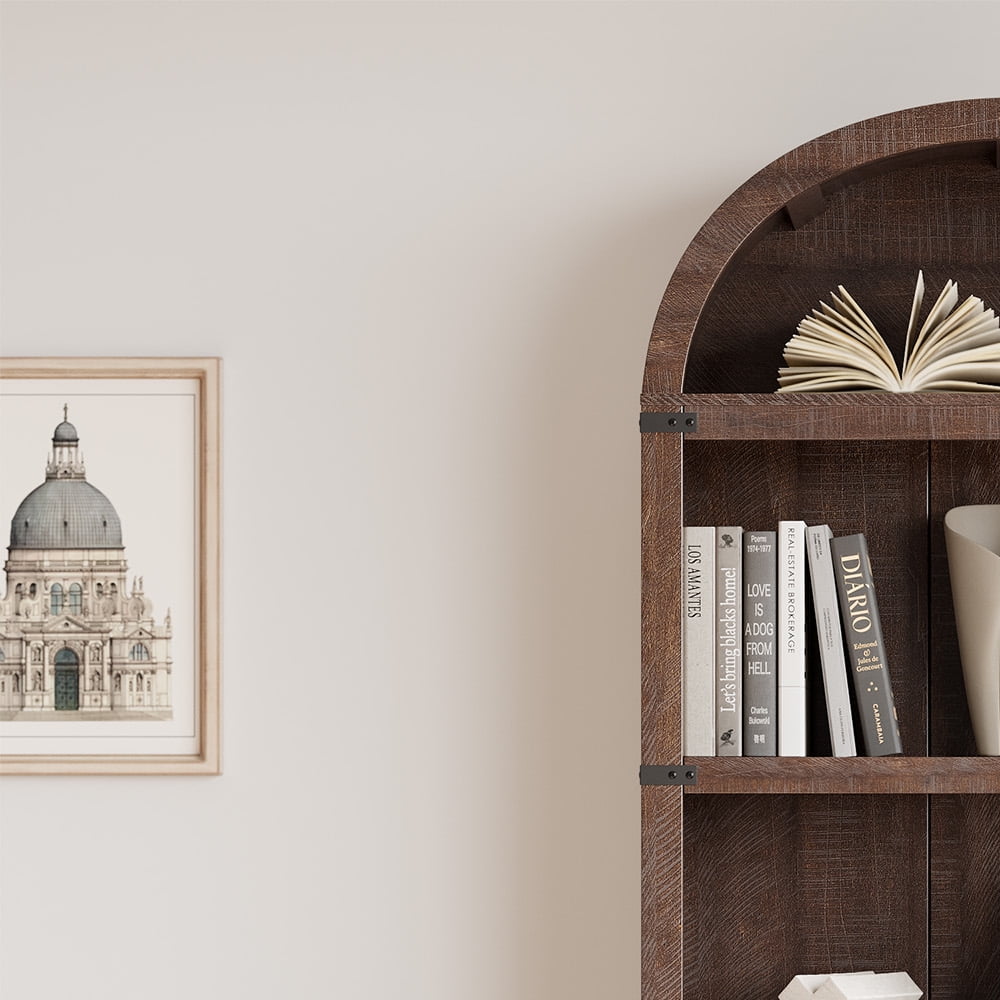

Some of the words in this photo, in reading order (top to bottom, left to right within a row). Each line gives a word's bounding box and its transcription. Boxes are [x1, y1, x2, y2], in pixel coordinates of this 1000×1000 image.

[687, 545, 702, 564] LOS
[787, 527, 796, 589] REAL-ESTATE
[687, 567, 702, 618] AMANTES
[720, 567, 737, 606] home!
[747, 583, 771, 597] LOVE
[840, 553, 872, 633] DIÁRIO
[754, 602, 764, 617] IS
[720, 608, 737, 646] blacks
[745, 622, 753, 636] A
[753, 622, 774, 636] DOG
[787, 591, 796, 654] BROKERAGE
[747, 642, 772, 656] FROM
[853, 640, 878, 650] Edmond
[720, 648, 740, 681] bring
[748, 662, 771, 675] HELL
[856, 663, 883, 672] Goncourt
[857, 657, 871, 666] Jules
[720, 682, 736, 713] Let's
